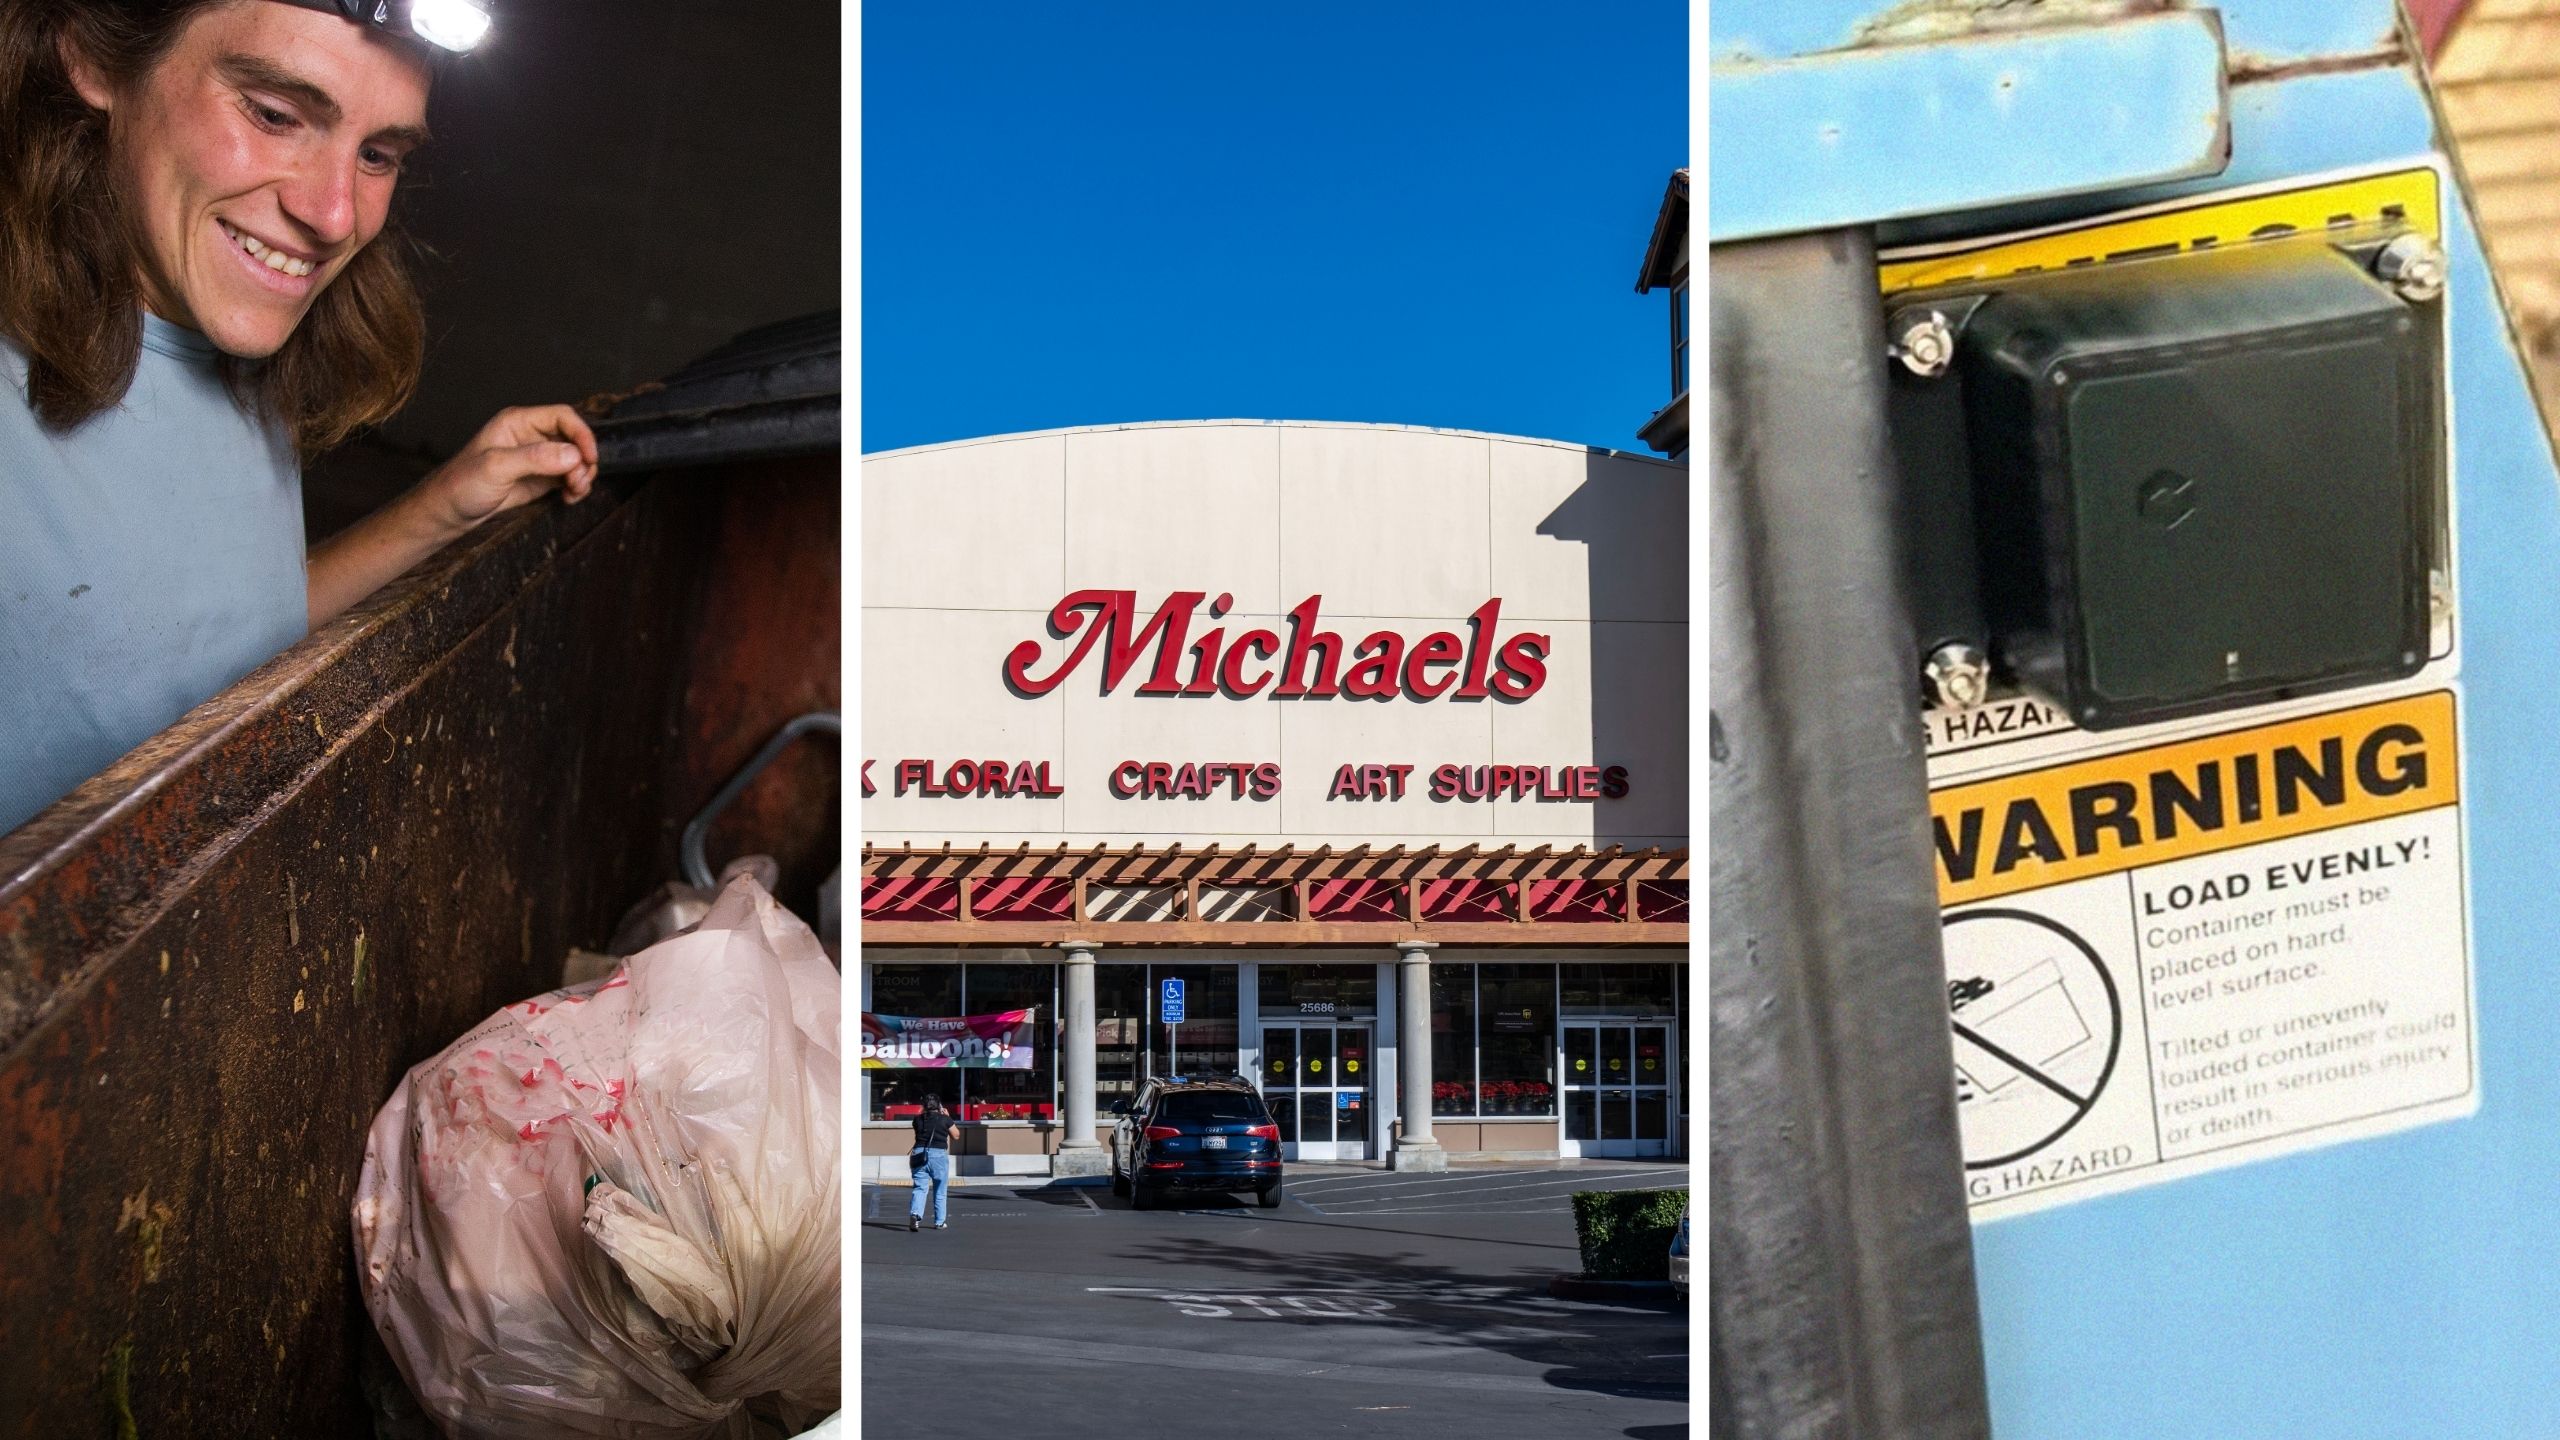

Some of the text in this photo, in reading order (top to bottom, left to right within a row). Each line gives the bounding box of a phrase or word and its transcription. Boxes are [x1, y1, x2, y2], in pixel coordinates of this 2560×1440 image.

[1006, 589, 1551, 700] Michaels
[899, 758, 1065, 796] FLORAL
[1114, 760, 1283, 798] CRAFTS
[1334, 763, 1415, 797] ART
[1435, 763, 1630, 800] SUPPLIES
[2144, 836, 2431, 916] LOAD EVENLY!
[2147, 884, 2390, 949] Container must be
[2150, 946, 2238, 986] placed
[2246, 940, 2279, 961] on
[1300, 1003, 1335, 1013] 25686
[2152, 980, 2213, 1012] level
[861, 1031, 1012, 1060] Balloons!
[900, 1019, 966, 1031] We Have
[2158, 997, 2390, 1060] Tilted or unevenly
[2160, 1011, 2458, 1090] loaded container could
[2162, 1043, 2451, 1117] result in serious injury
[2167, 1125, 2192, 1145] or
[2002, 1144, 2133, 1191] HAZARD
[1156, 1294, 1396, 1317] STOP
